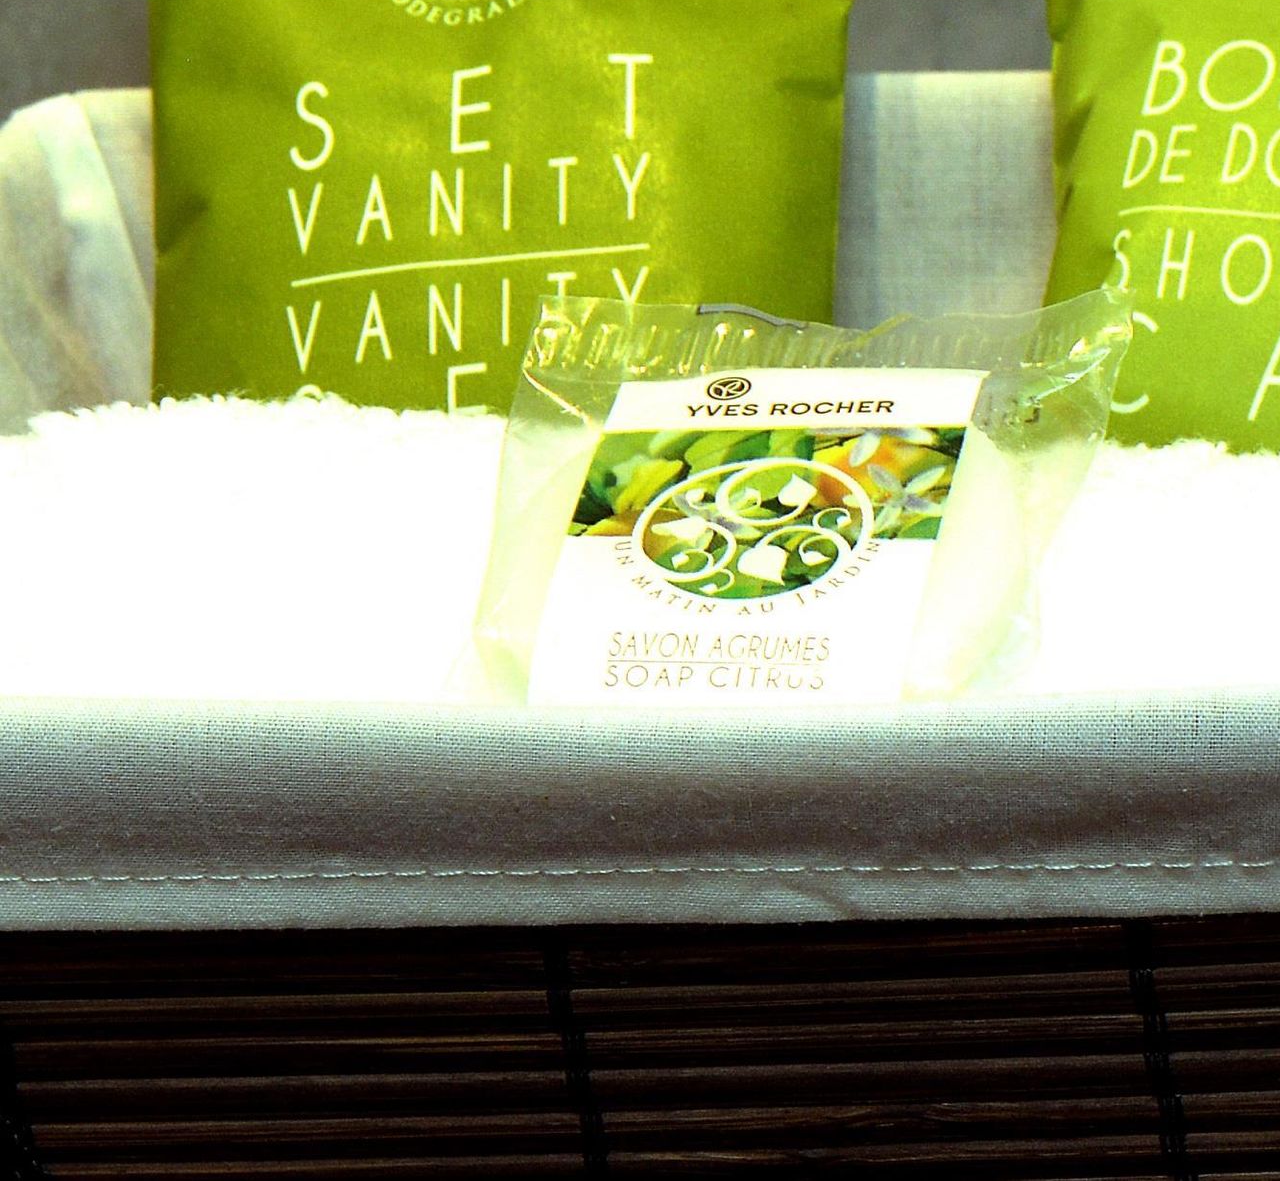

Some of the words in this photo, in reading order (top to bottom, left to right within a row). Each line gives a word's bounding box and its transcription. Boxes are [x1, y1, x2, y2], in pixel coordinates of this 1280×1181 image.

[289, 54, 653, 171] SET
[1122, 124, 1197, 189] DE
[288, 152, 650, 254] VANITY
[687, 403, 758, 417] YVES
[770, 400, 895, 416] ROCHER
[614, 540, 635, 566] UN
[631, 574, 716, 614] MATIN
[737, 602, 775, 616] AU
[797, 540, 881, 605] JARDIN
[604, 664, 694, 688] SOAP
[608, 631, 699, 658] SAVON
[709, 634, 831, 662] AGRUMES
